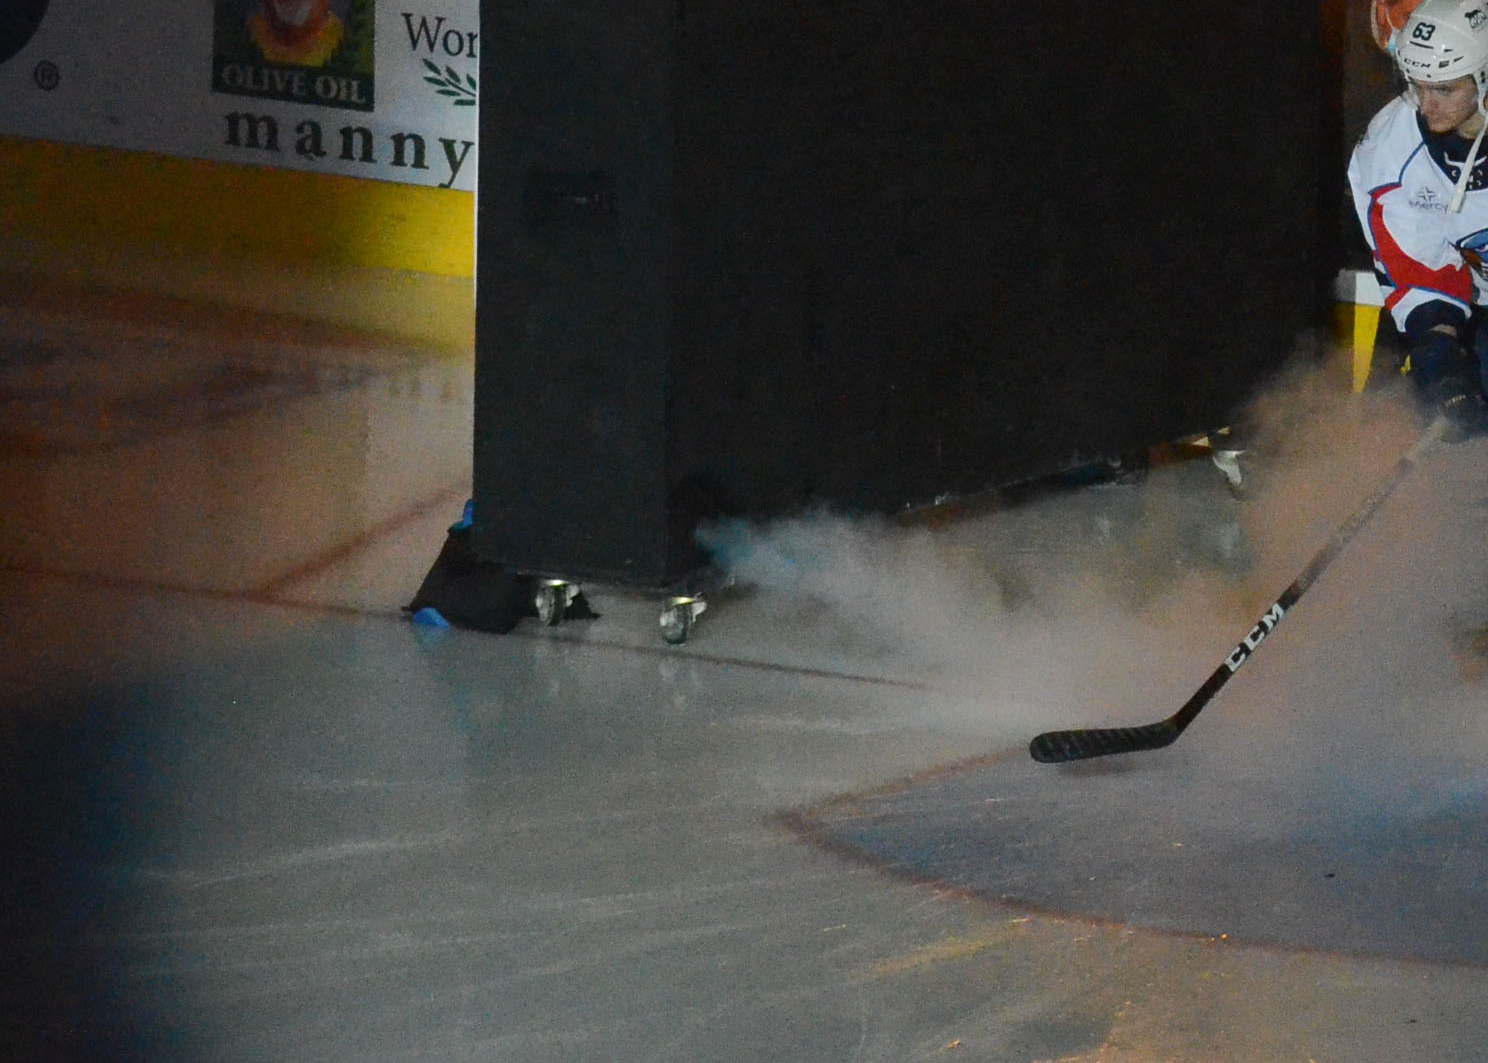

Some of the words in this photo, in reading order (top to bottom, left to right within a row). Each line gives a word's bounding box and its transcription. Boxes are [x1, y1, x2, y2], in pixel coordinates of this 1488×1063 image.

[1412, 21, 1437, 42] 63
[221, 63, 308, 96] OLIVE
[314, 72, 368, 104] OIL
[1403, 57, 1432, 69] CCM
[224, 109, 476, 189] manny
[1224, 602, 1285, 673] CCM
